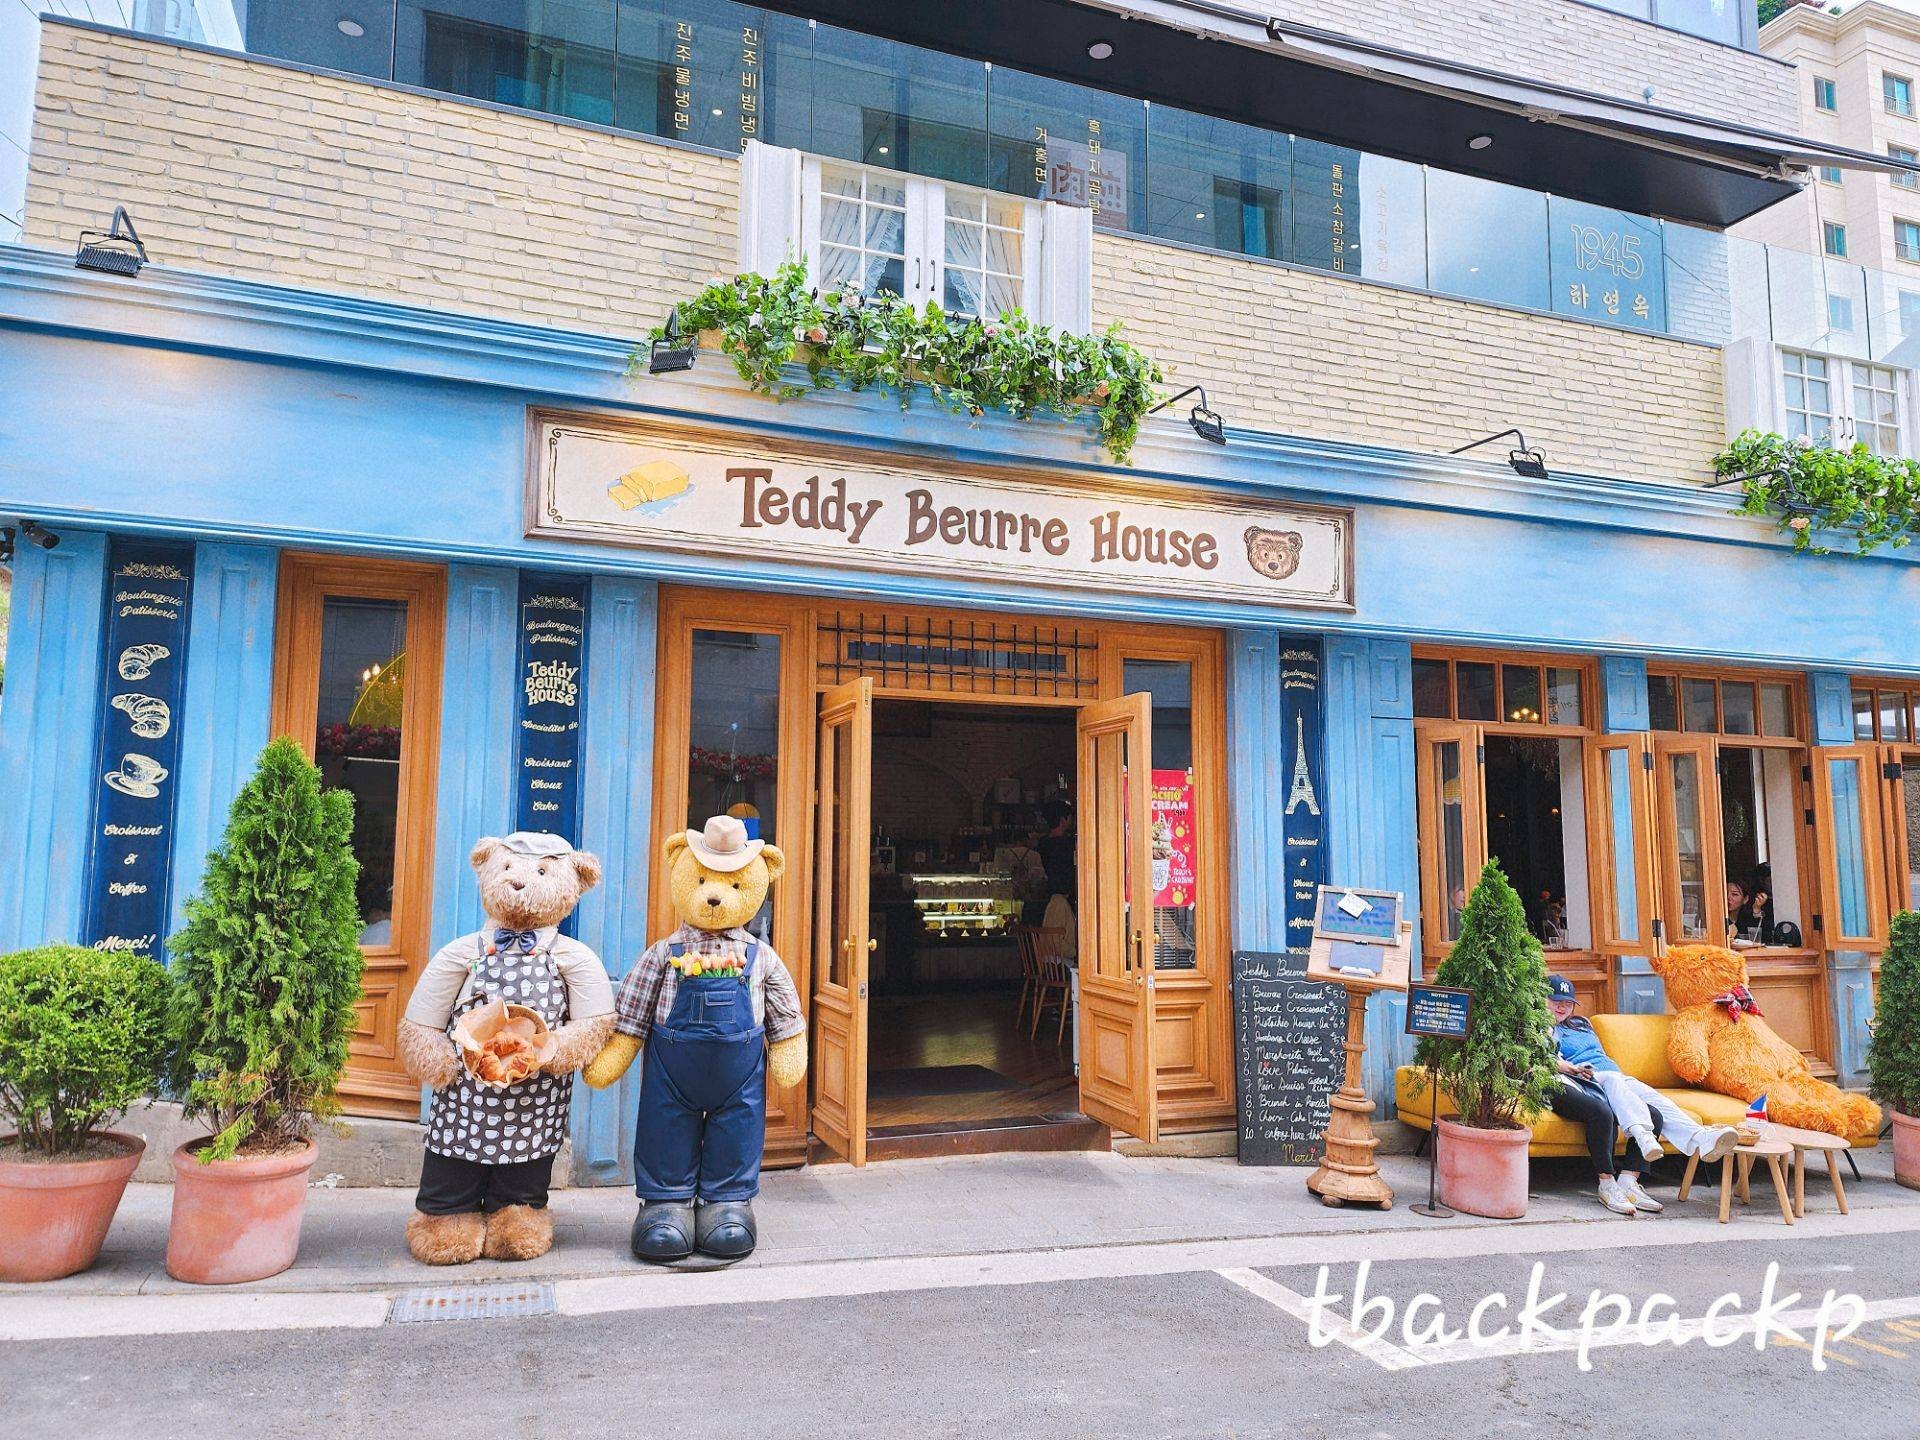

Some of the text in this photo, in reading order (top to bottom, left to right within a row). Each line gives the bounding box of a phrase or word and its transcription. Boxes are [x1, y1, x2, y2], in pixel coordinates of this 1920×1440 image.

[674, 22, 692, 131] 진주물냉면
[1571, 223, 1645, 280] 1945
[1570, 283, 1649, 320] 하연옥
[725, 468, 1220, 570] Teddy Beurre House
[115, 590, 184, 607] Boulangerie
[119, 605, 178, 620] Patisserie
[526, 620, 582, 634] Boulangerie
[530, 634, 578, 646] Patisserie
[527, 659, 579, 681] Teddy
[525, 676, 578, 695] Beurre
[524, 758, 572, 768] Croissant
[531, 779, 563, 790] Choux
[533, 801, 559, 811] Cake
[104, 824, 163, 836] Croissant
[124, 853, 138, 865] &
[109, 881, 148, 897] Coffee
[94, 934, 157, 952] Merci!
